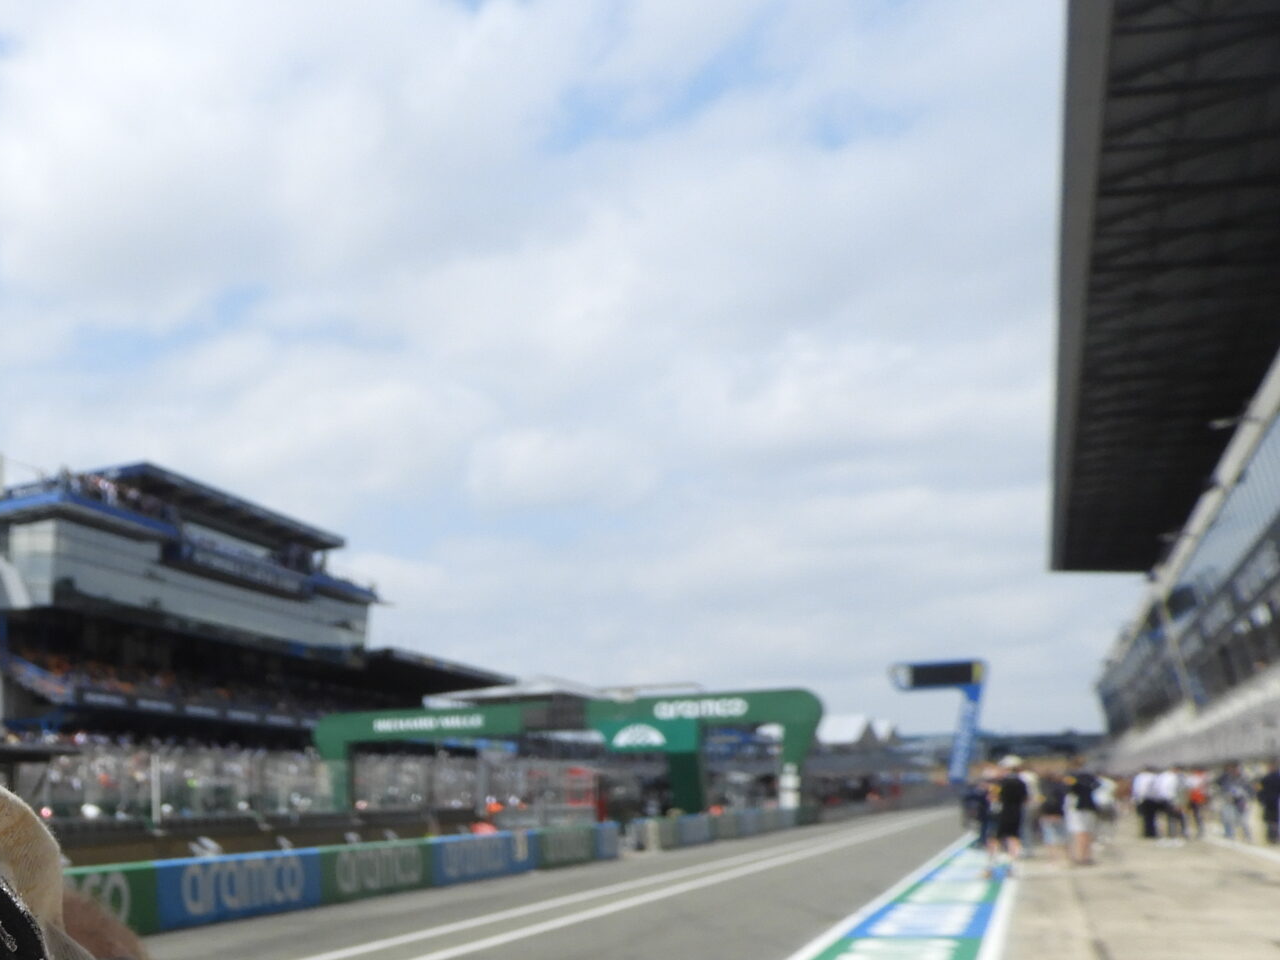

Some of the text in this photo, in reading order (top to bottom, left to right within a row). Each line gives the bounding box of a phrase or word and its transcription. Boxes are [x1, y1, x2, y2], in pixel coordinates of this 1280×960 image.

[654, 698, 748, 722] aramco
[180, 856, 305, 916] aramco
[335, 843, 419, 893] aramco
